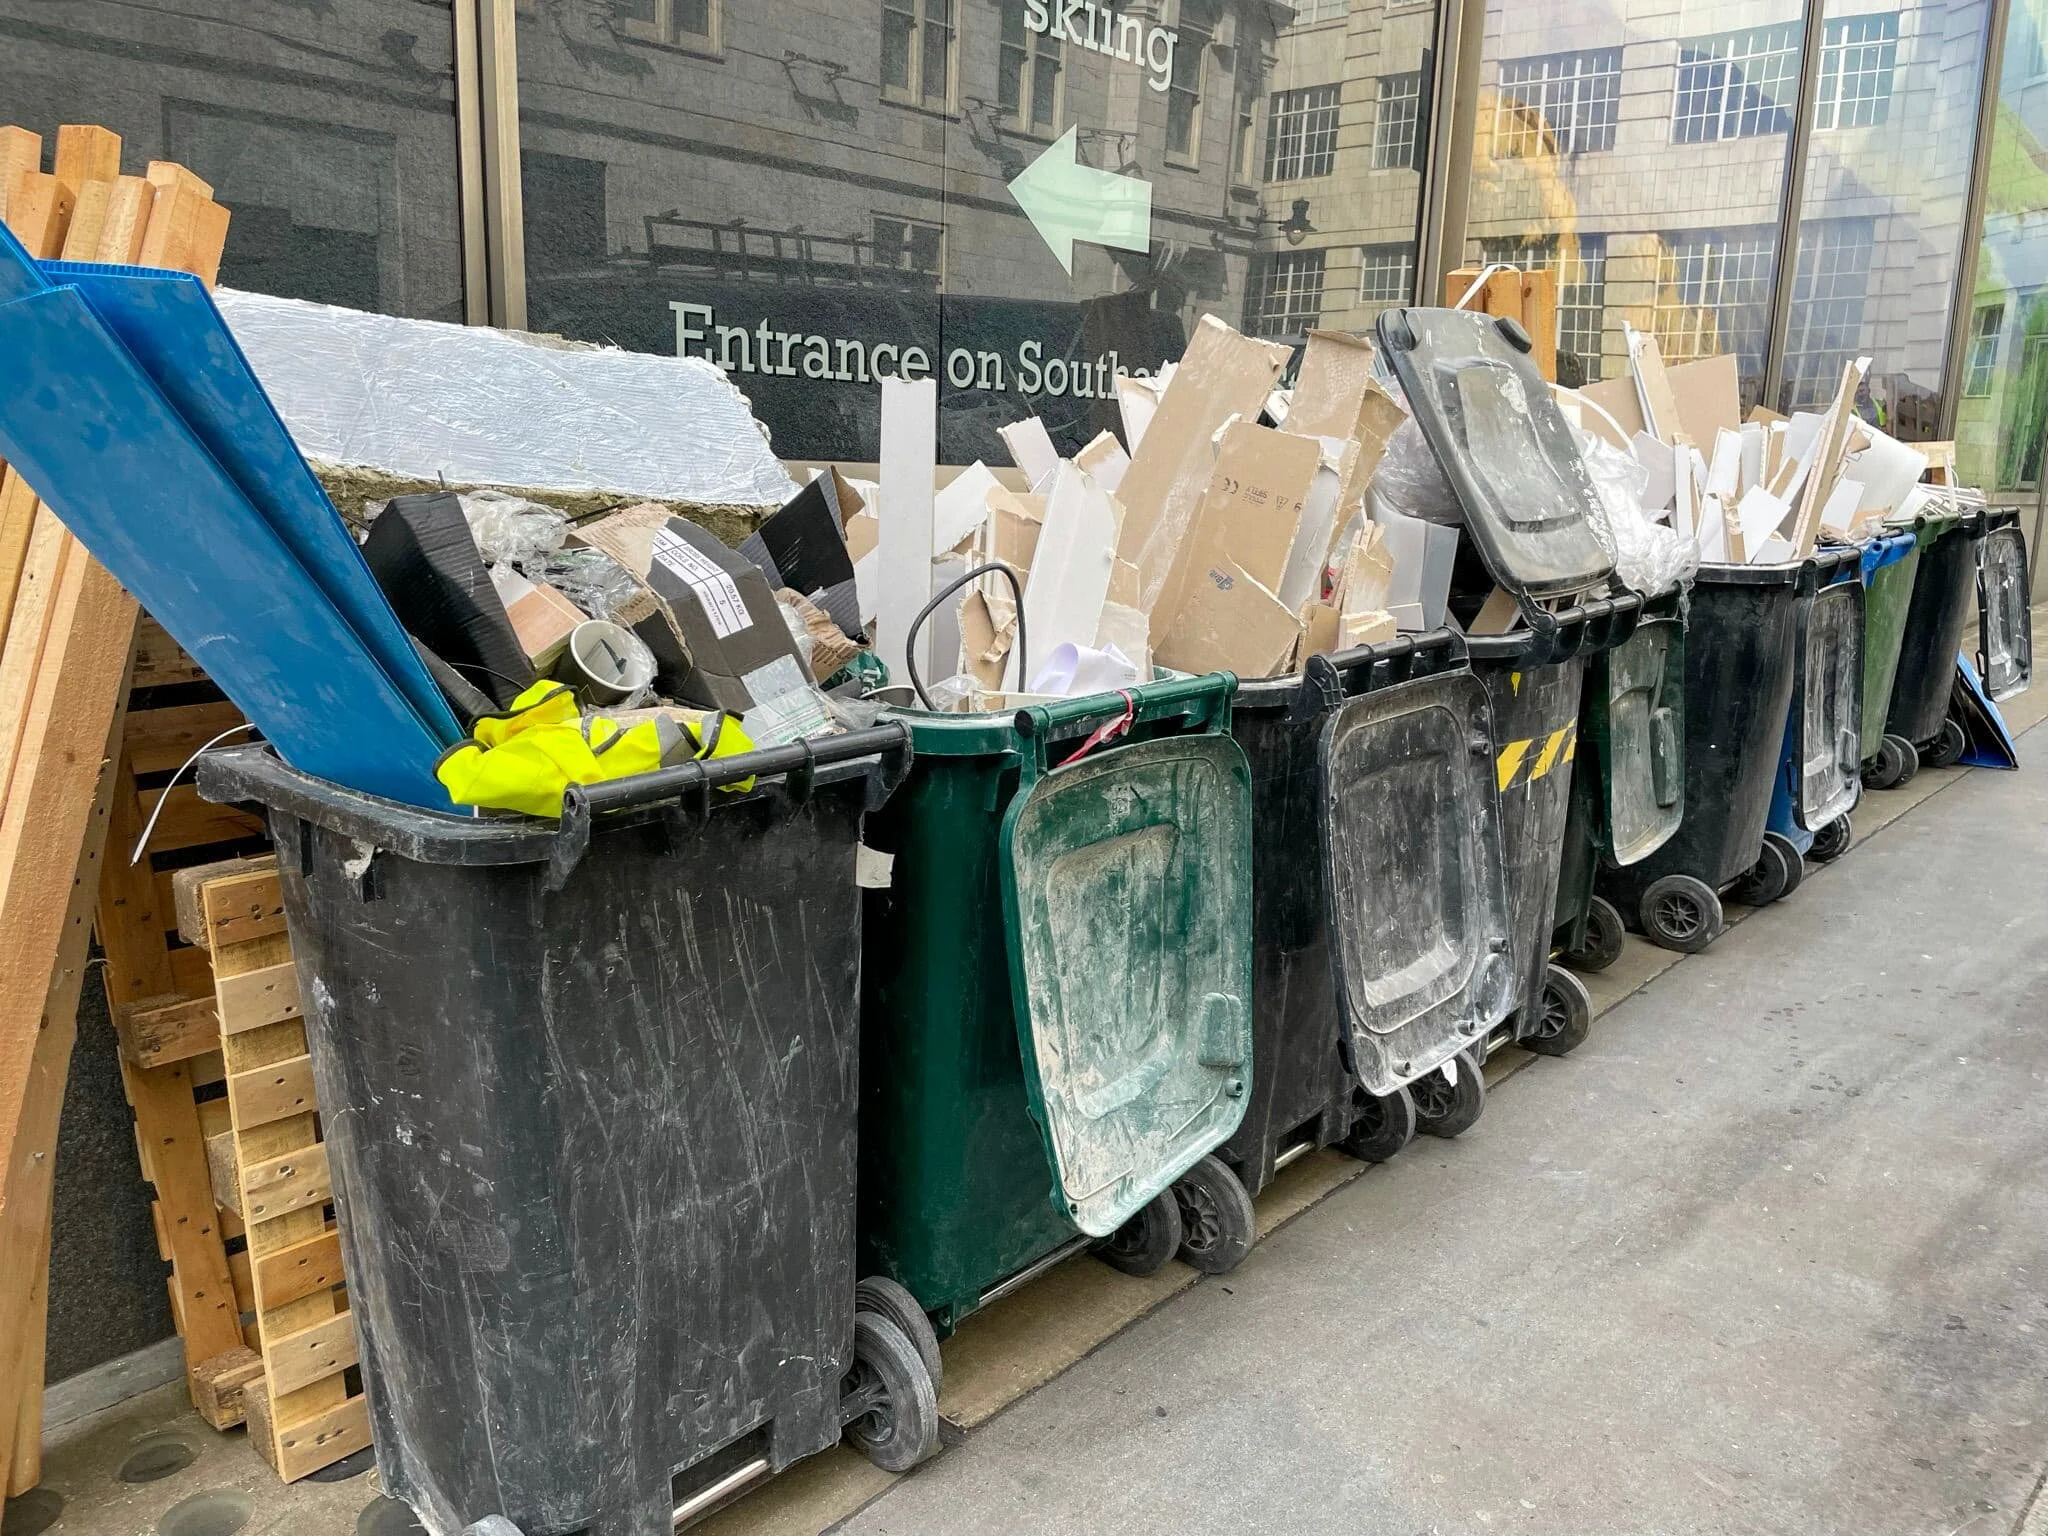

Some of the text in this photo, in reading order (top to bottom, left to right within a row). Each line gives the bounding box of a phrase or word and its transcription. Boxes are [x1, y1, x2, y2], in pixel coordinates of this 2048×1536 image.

[1023, 0, 1178, 92] skiing
[669, 300, 930, 383] Entrance
[947, 347, 1006, 391] on
